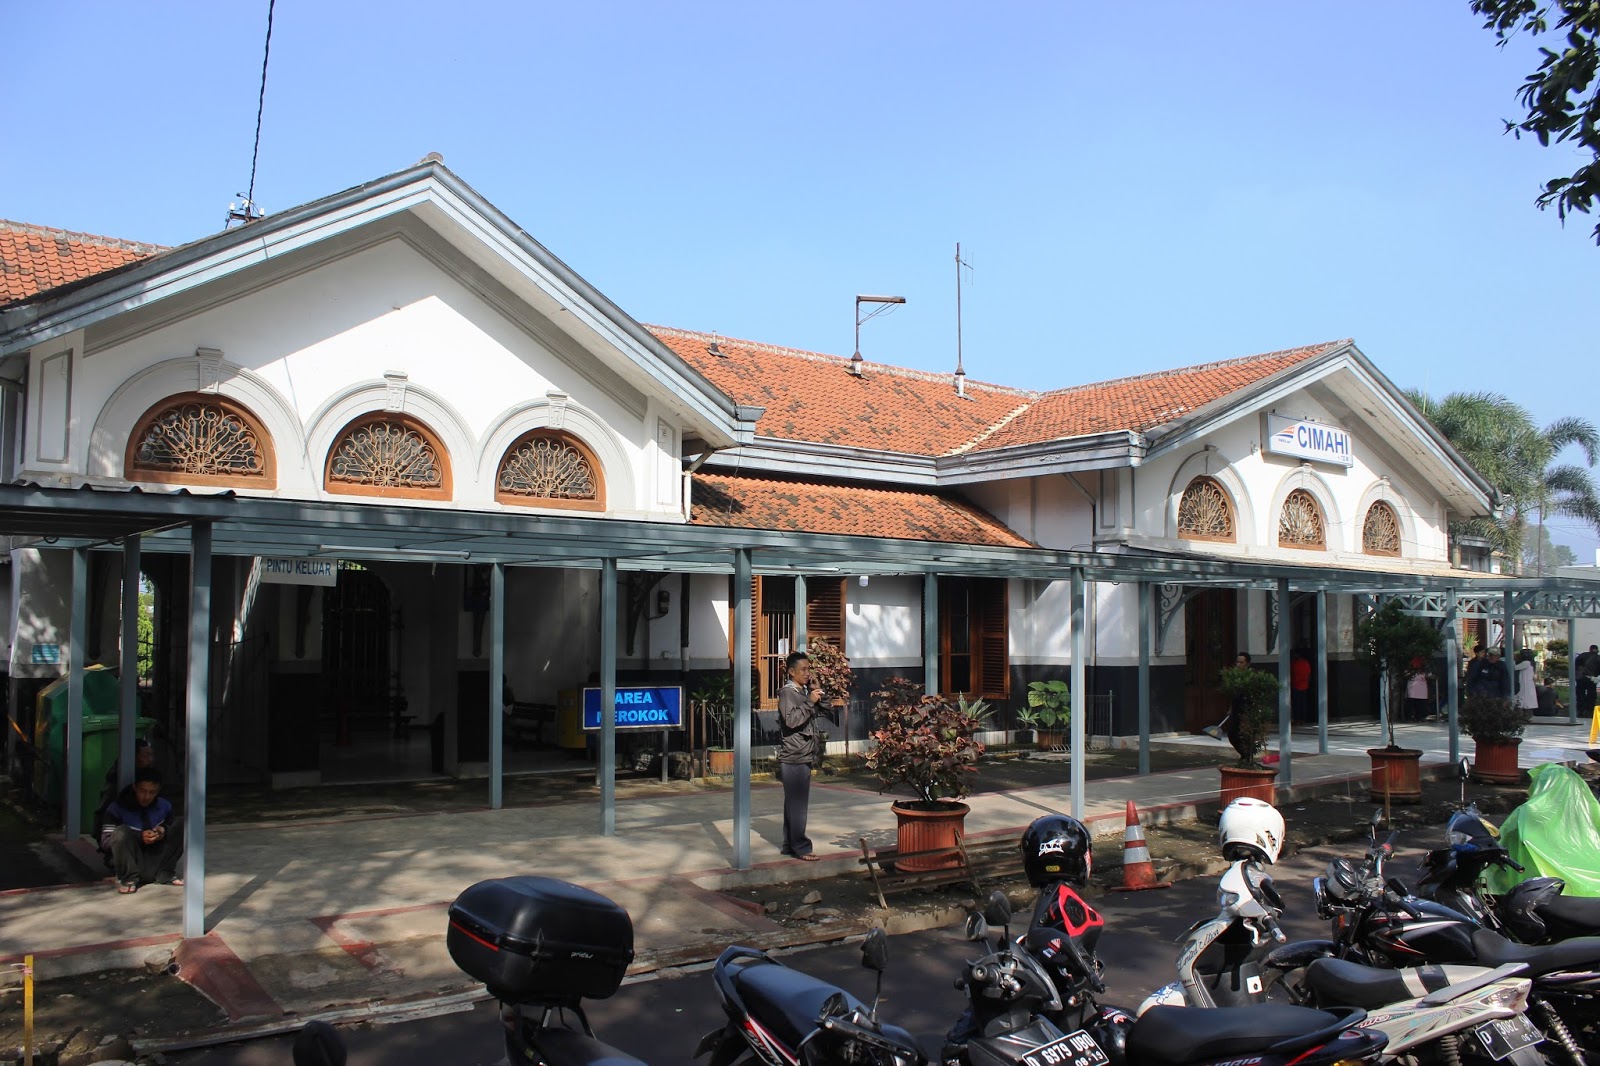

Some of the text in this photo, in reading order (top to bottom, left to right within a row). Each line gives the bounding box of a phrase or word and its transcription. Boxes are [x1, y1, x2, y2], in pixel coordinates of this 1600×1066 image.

[1297, 425, 1349, 455] CIMAHI
[266, 558, 331, 576] PINTU KELUAR
[614, 692, 652, 705] AREA
[1480, 1030, 1492, 1044] D
[1041, 1043, 1072, 1064] 6979
